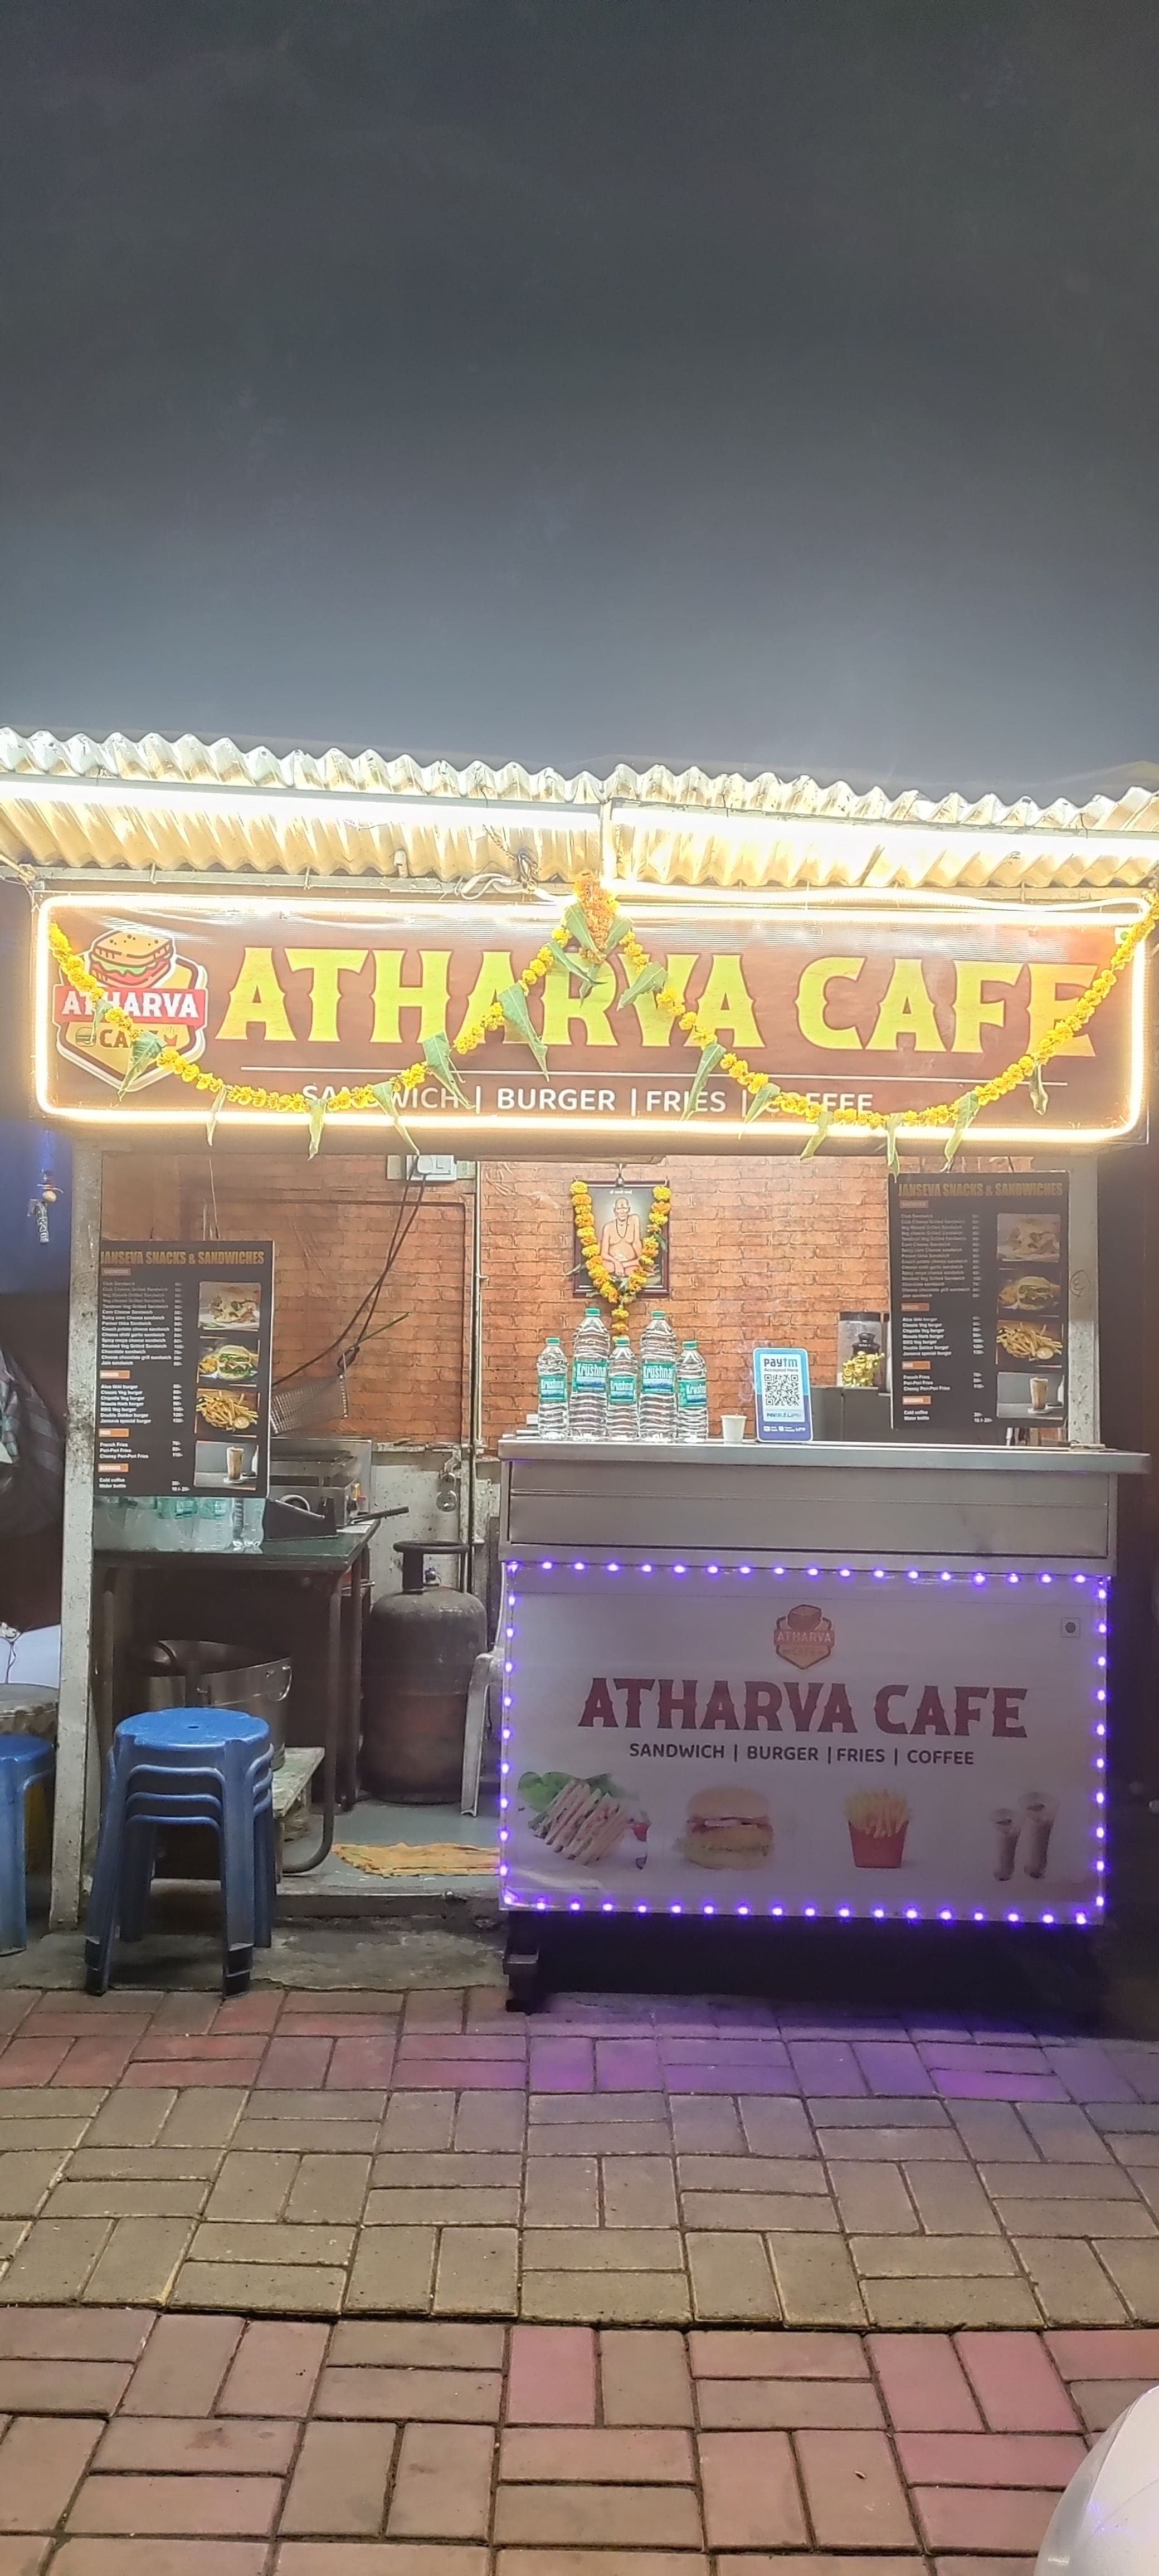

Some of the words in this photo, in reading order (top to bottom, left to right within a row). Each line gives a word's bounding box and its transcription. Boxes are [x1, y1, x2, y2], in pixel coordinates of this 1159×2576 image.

[216, 947, 766, 1048] ATHARVA
[795, 956, 1098, 1057] CAFE
[100, 1029, 158, 1048] CA
[303, 1085, 459, 1109] SAWICH
[496, 1088, 615, 1111] BURGER
[646, 1090, 727, 1113] FRIES
[943, 1183, 983, 1197] SNACKS
[986, 1185, 993, 1196] &
[995, 1182, 1063, 1197] SANDWICHES
[145, 1251, 186, 1265] SNACKS
[188, 1253, 195, 1265] &
[197, 1251, 265, 1265] SANDWICHES
[764, 1358, 797, 1367] paytm
[777, 1632, 831, 1642] ATHARVA
[578, 1677, 858, 1733] ATHARVA
[874, 1684, 1028, 1738] CAFE
[629, 1743, 725, 1759] SANDWICH
[747, 1745, 819, 1761] BURGER
[837, 1748, 885, 1763] FRIES
[907, 1749, 975, 1765] COFFEE
